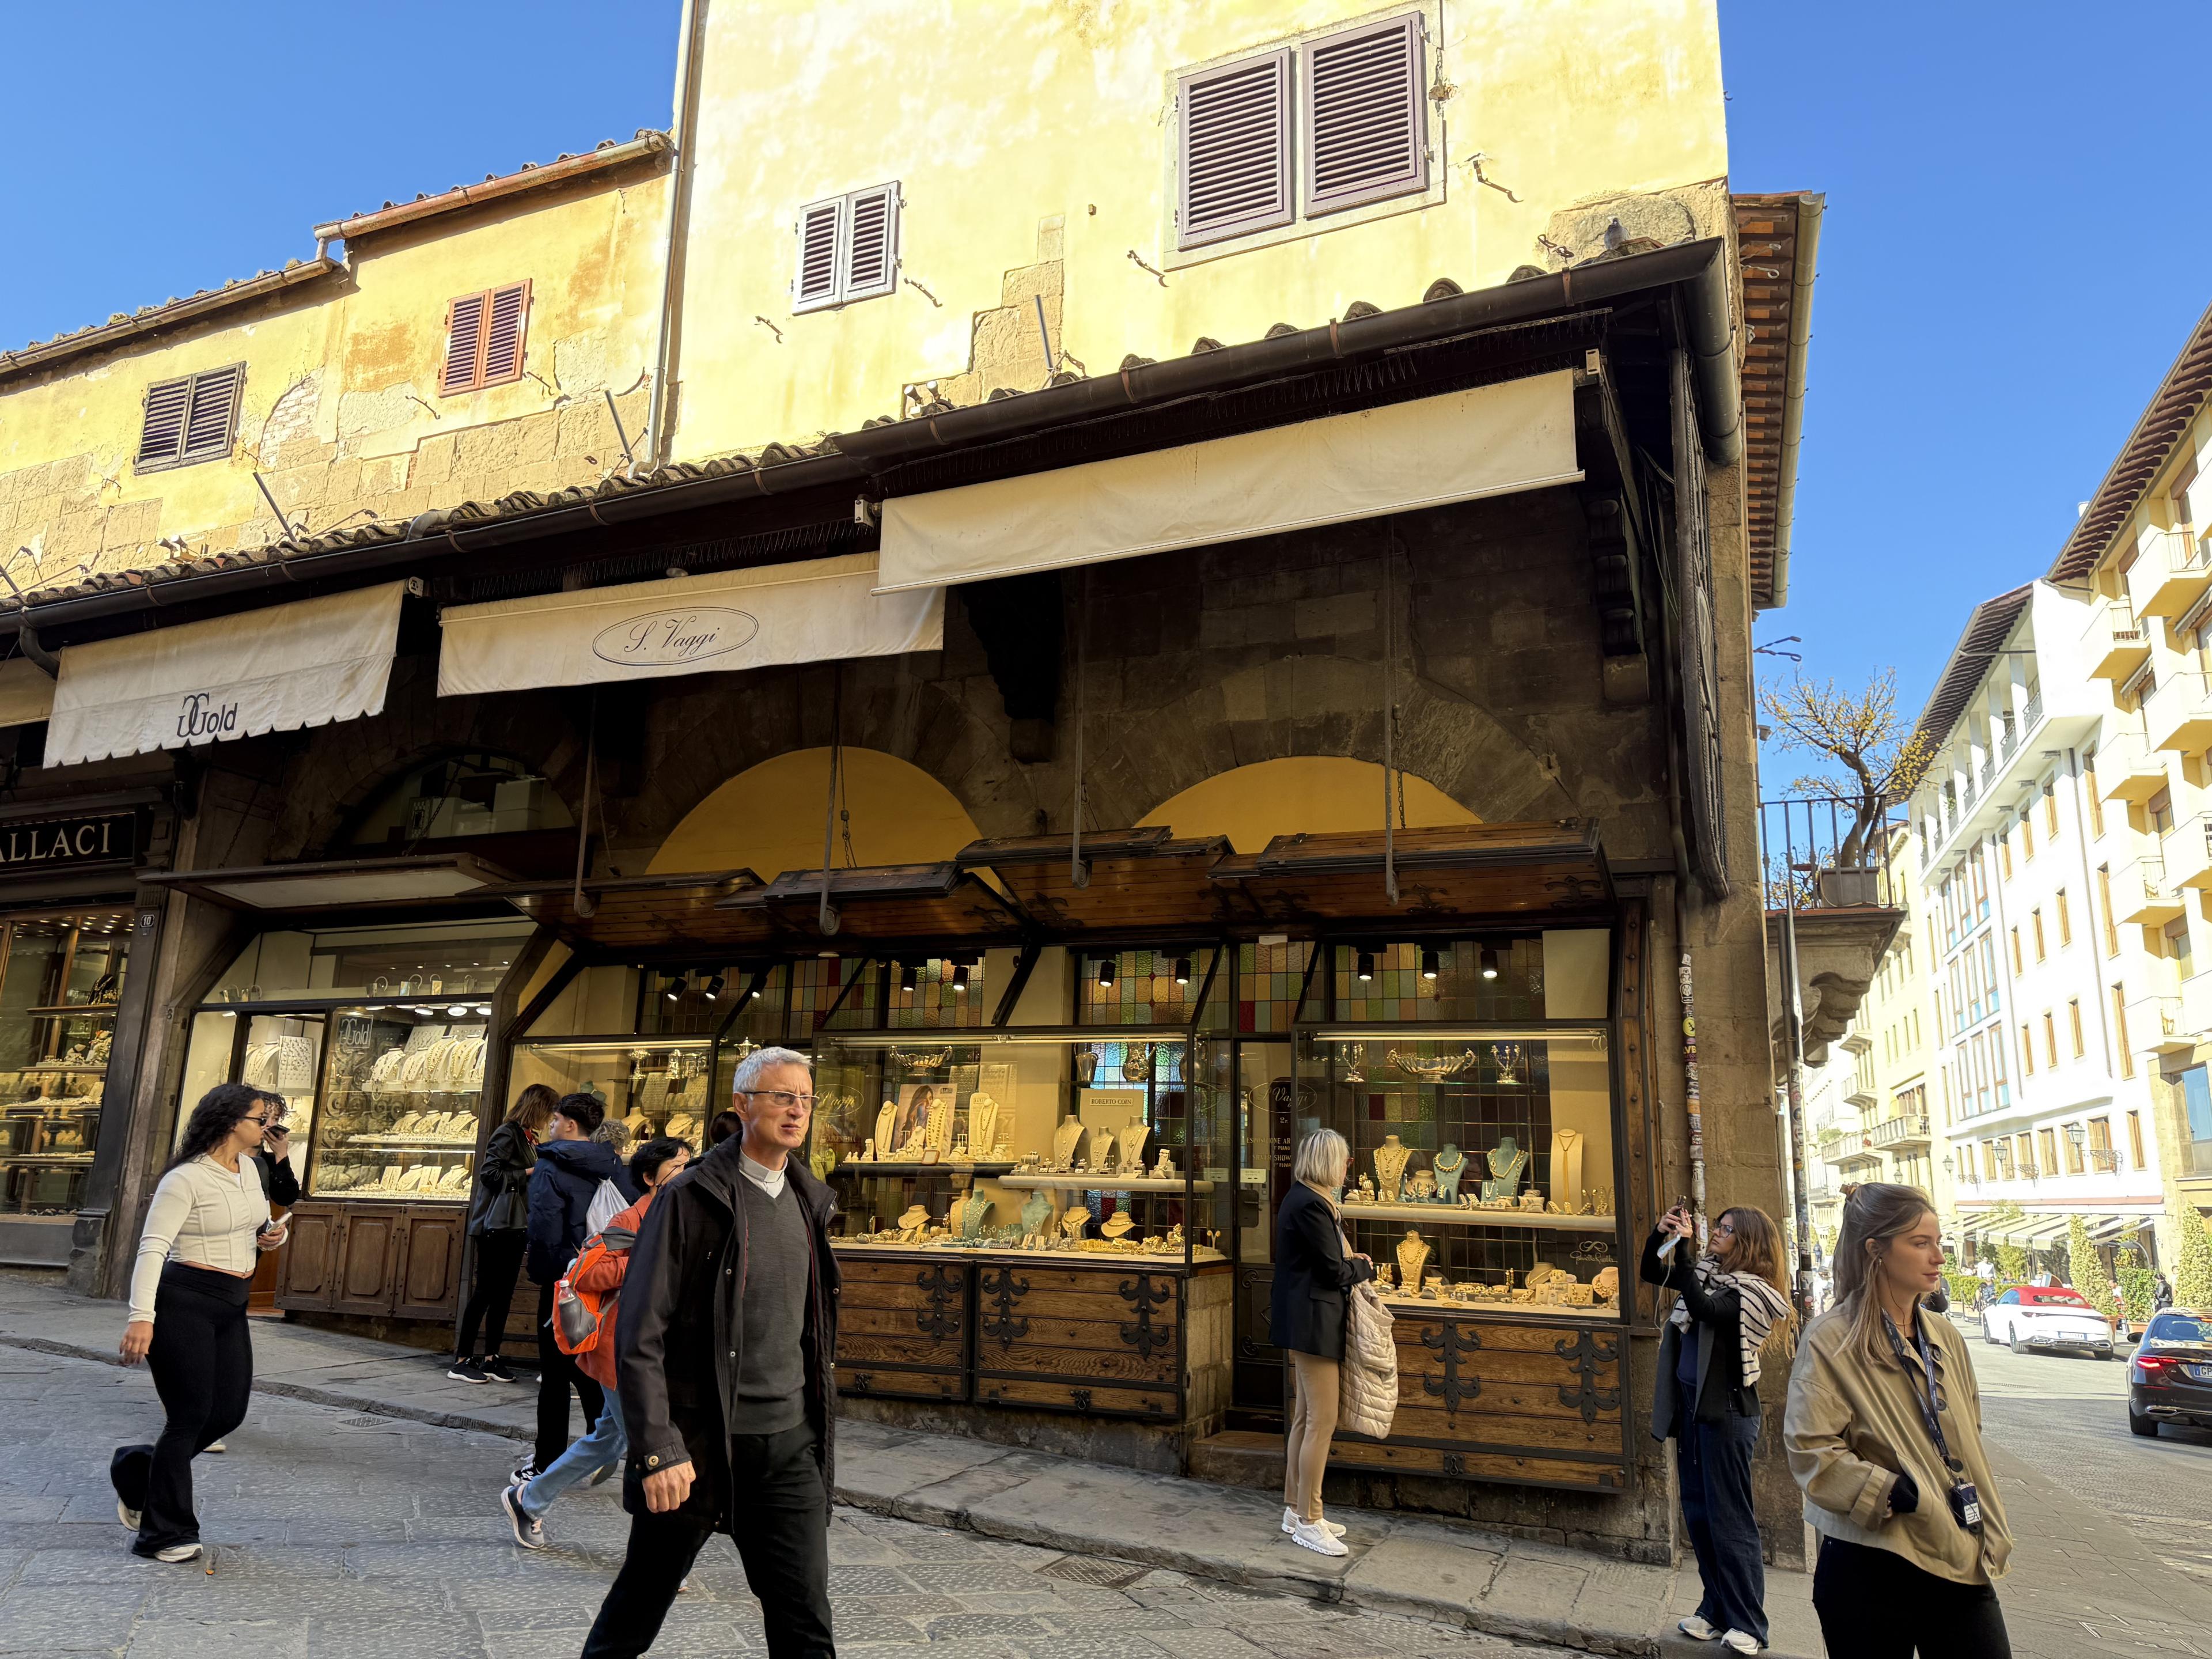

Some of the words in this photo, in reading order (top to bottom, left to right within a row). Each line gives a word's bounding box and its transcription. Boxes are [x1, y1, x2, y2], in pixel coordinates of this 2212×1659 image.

[661, 615, 720, 657] Vaggi
[0, 823, 111, 862] LLACI
[143, 916, 151, 926] 10
